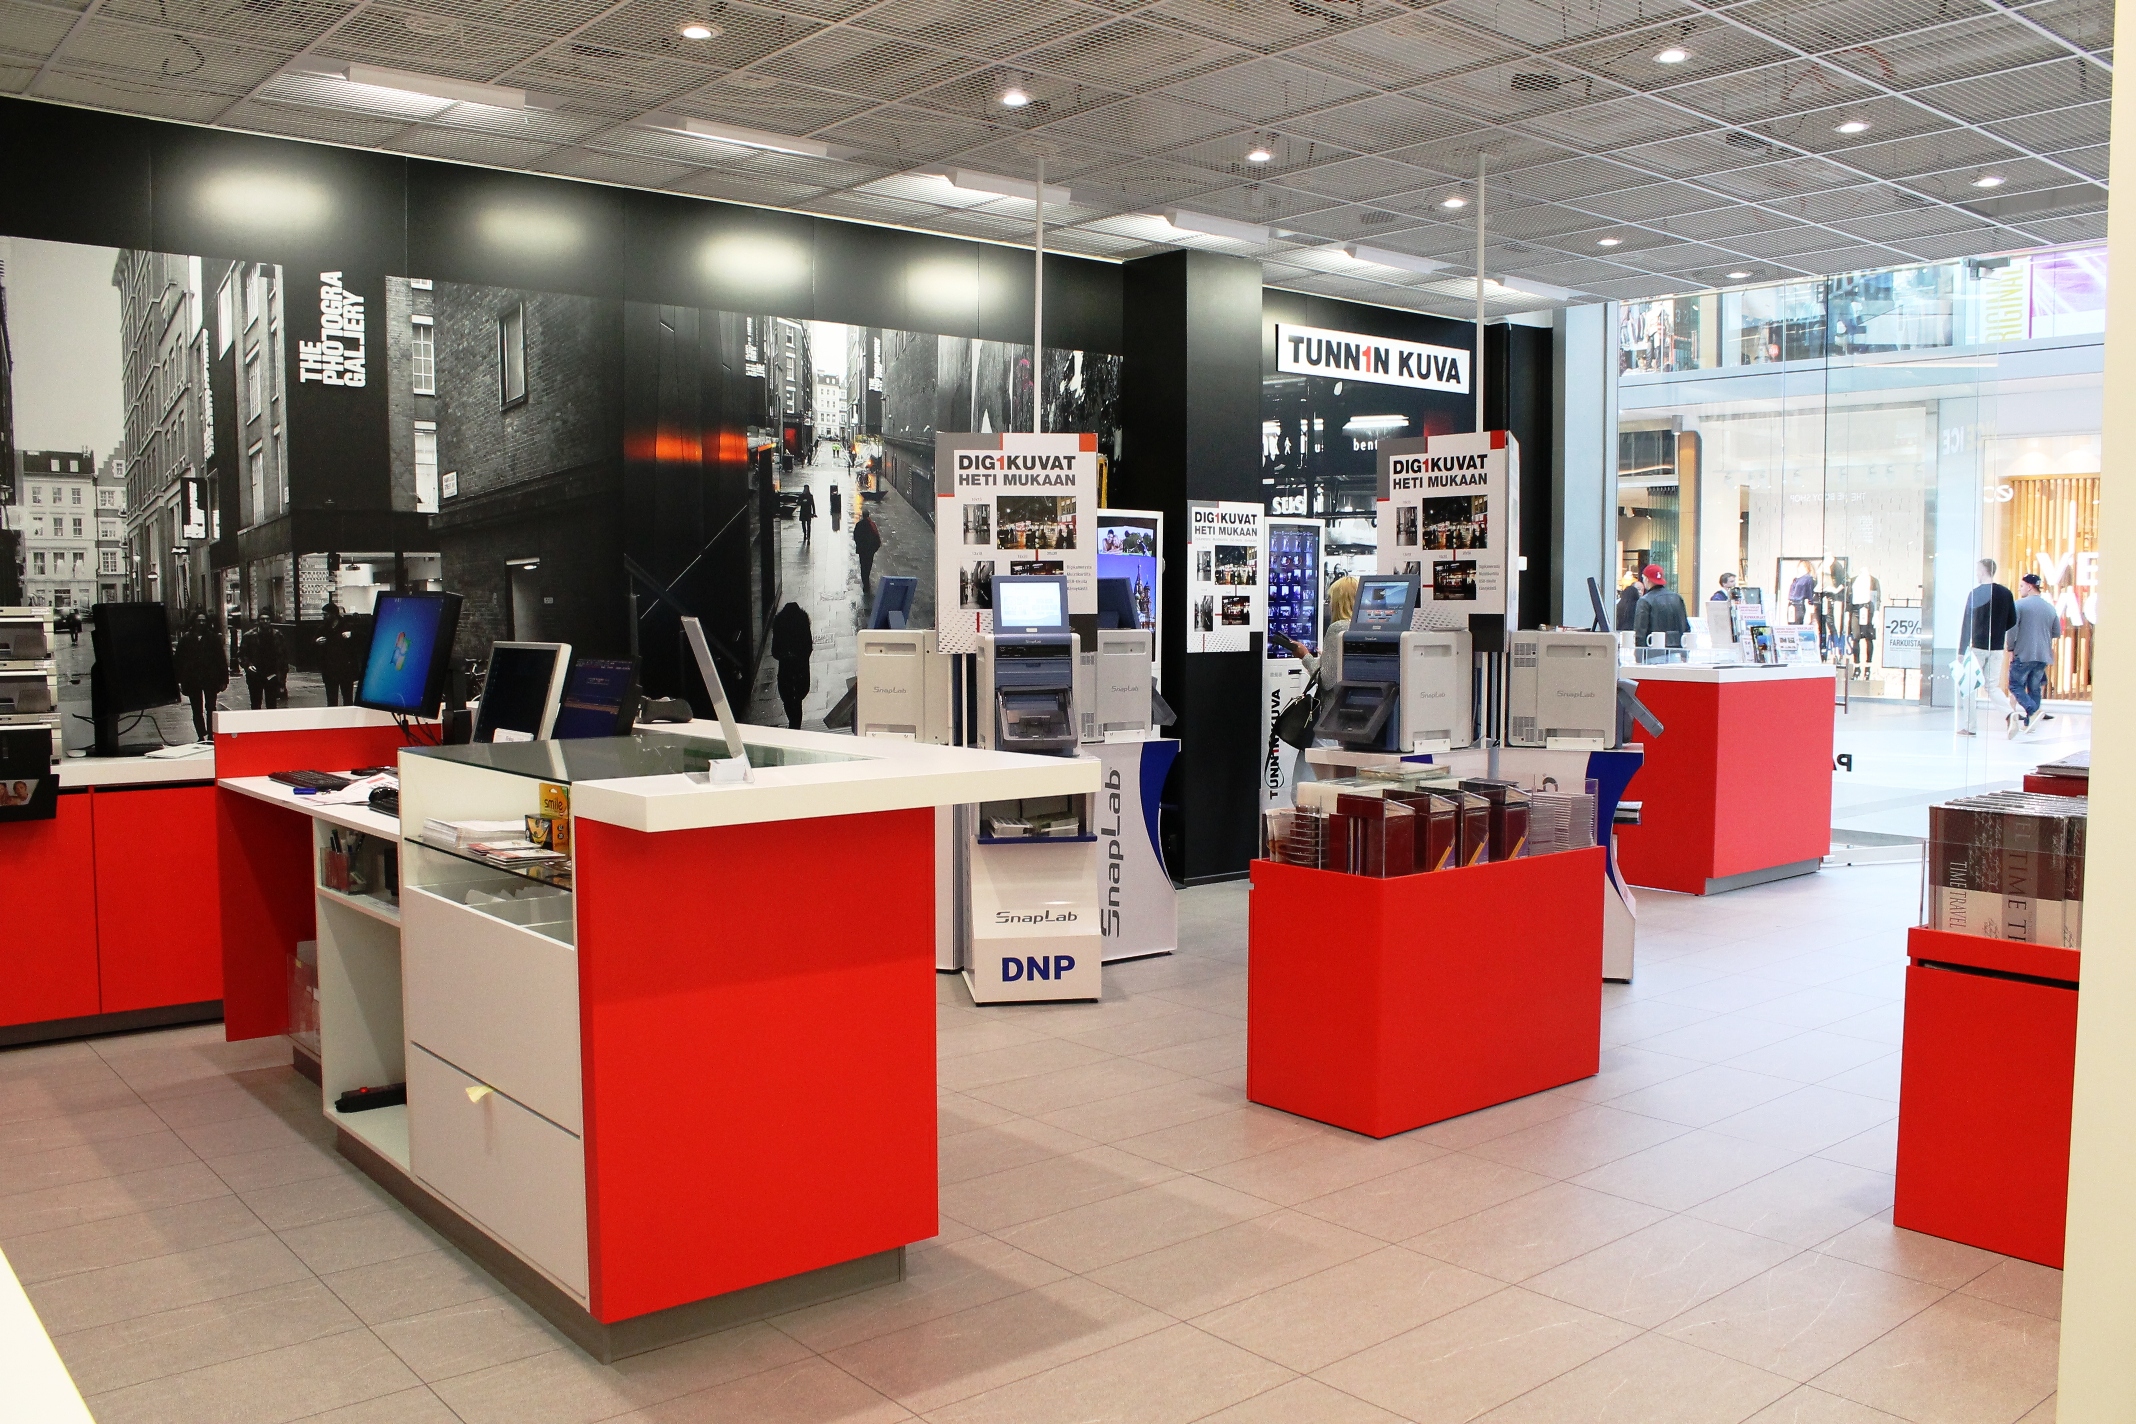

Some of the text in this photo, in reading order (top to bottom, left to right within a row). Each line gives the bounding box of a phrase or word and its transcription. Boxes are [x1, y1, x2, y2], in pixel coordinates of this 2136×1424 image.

[342, 289, 366, 388] GALLERY
[299, 340, 323, 383] THE
[1288, 334, 1462, 385] TUNN1N KUVA
[958, 455, 1077, 471] DIG1KUVAT
[1393, 454, 1488, 475] DIG1KUVAT
[958, 474, 1076, 486] HETI MUKAAN
[1393, 473, 1488, 490] HETI MUKAAN
[1194, 511, 1258, 525] DIG1KUVAT
[1194, 525, 1258, 537] HETI MUKAAN
[1885, 620, 1922, 635] -25%
[1100, 768, 1124, 938] SnapLab
[2007, 850, 2028, 910] TIME
[1949, 861, 1968, 929] TIME TRAVEL
[995, 910, 1078, 925] SnapLab
[1001, 954, 1076, 983] DNP
